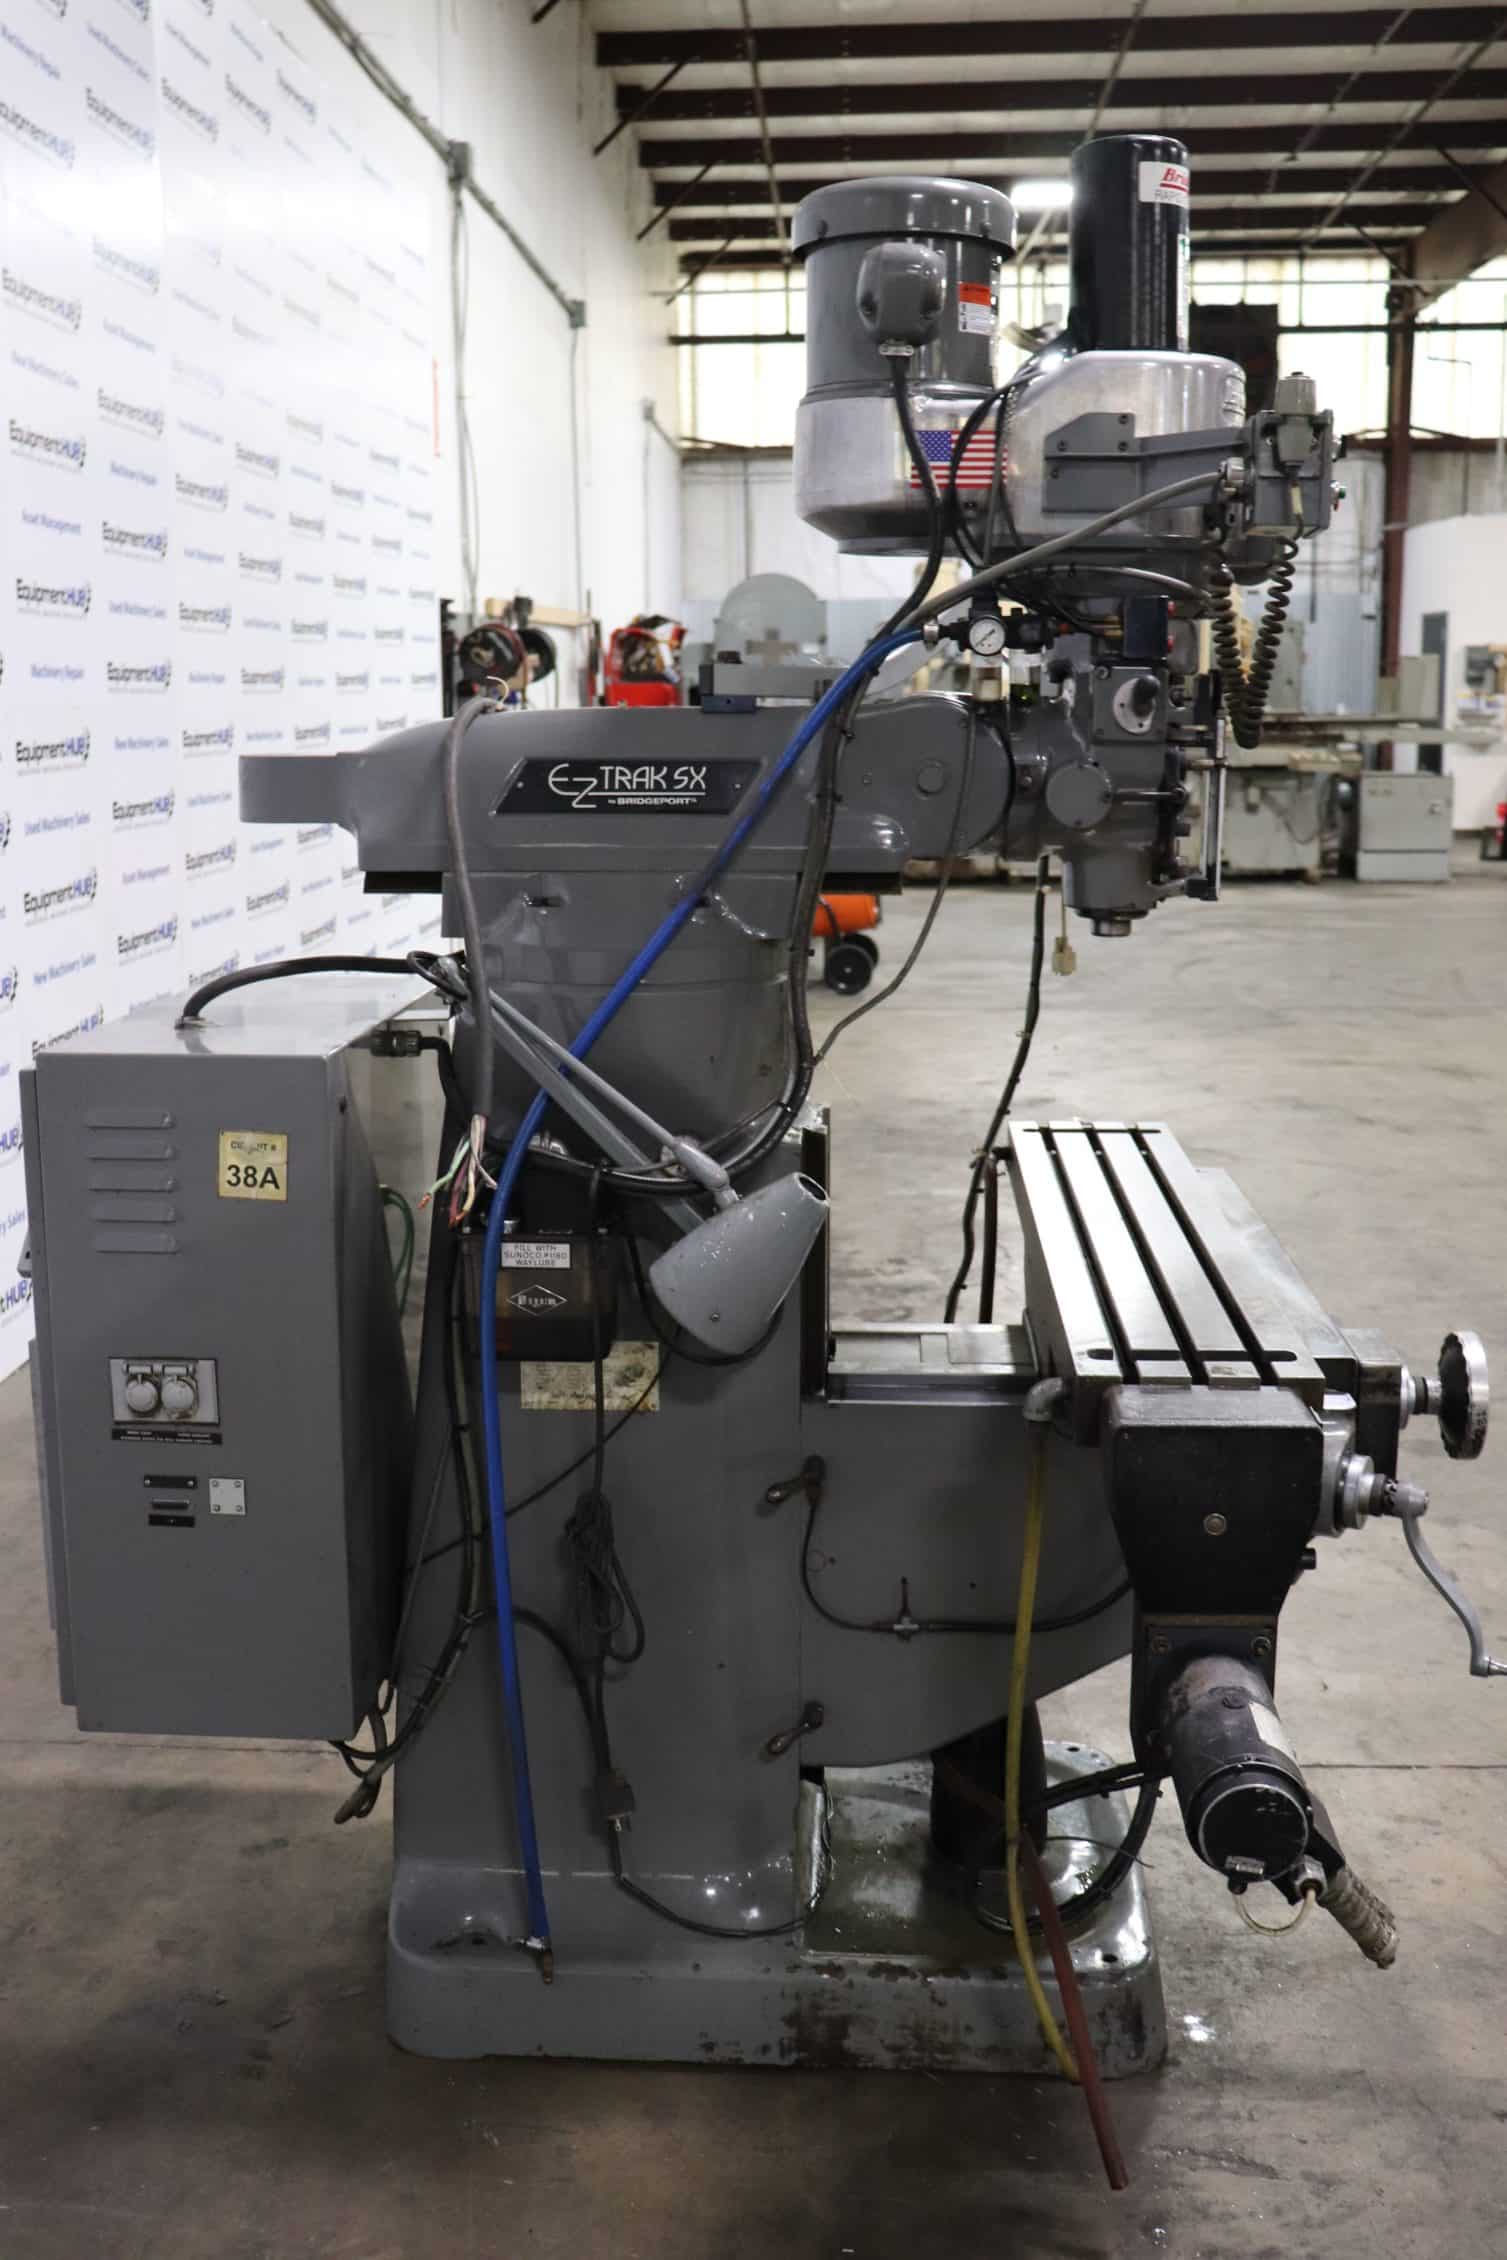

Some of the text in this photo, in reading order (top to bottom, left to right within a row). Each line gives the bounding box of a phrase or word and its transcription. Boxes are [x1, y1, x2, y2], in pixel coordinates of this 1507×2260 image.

[548, 763, 707, 808] EZ TRAK SX
[226, 1164, 280, 1190] 38A
